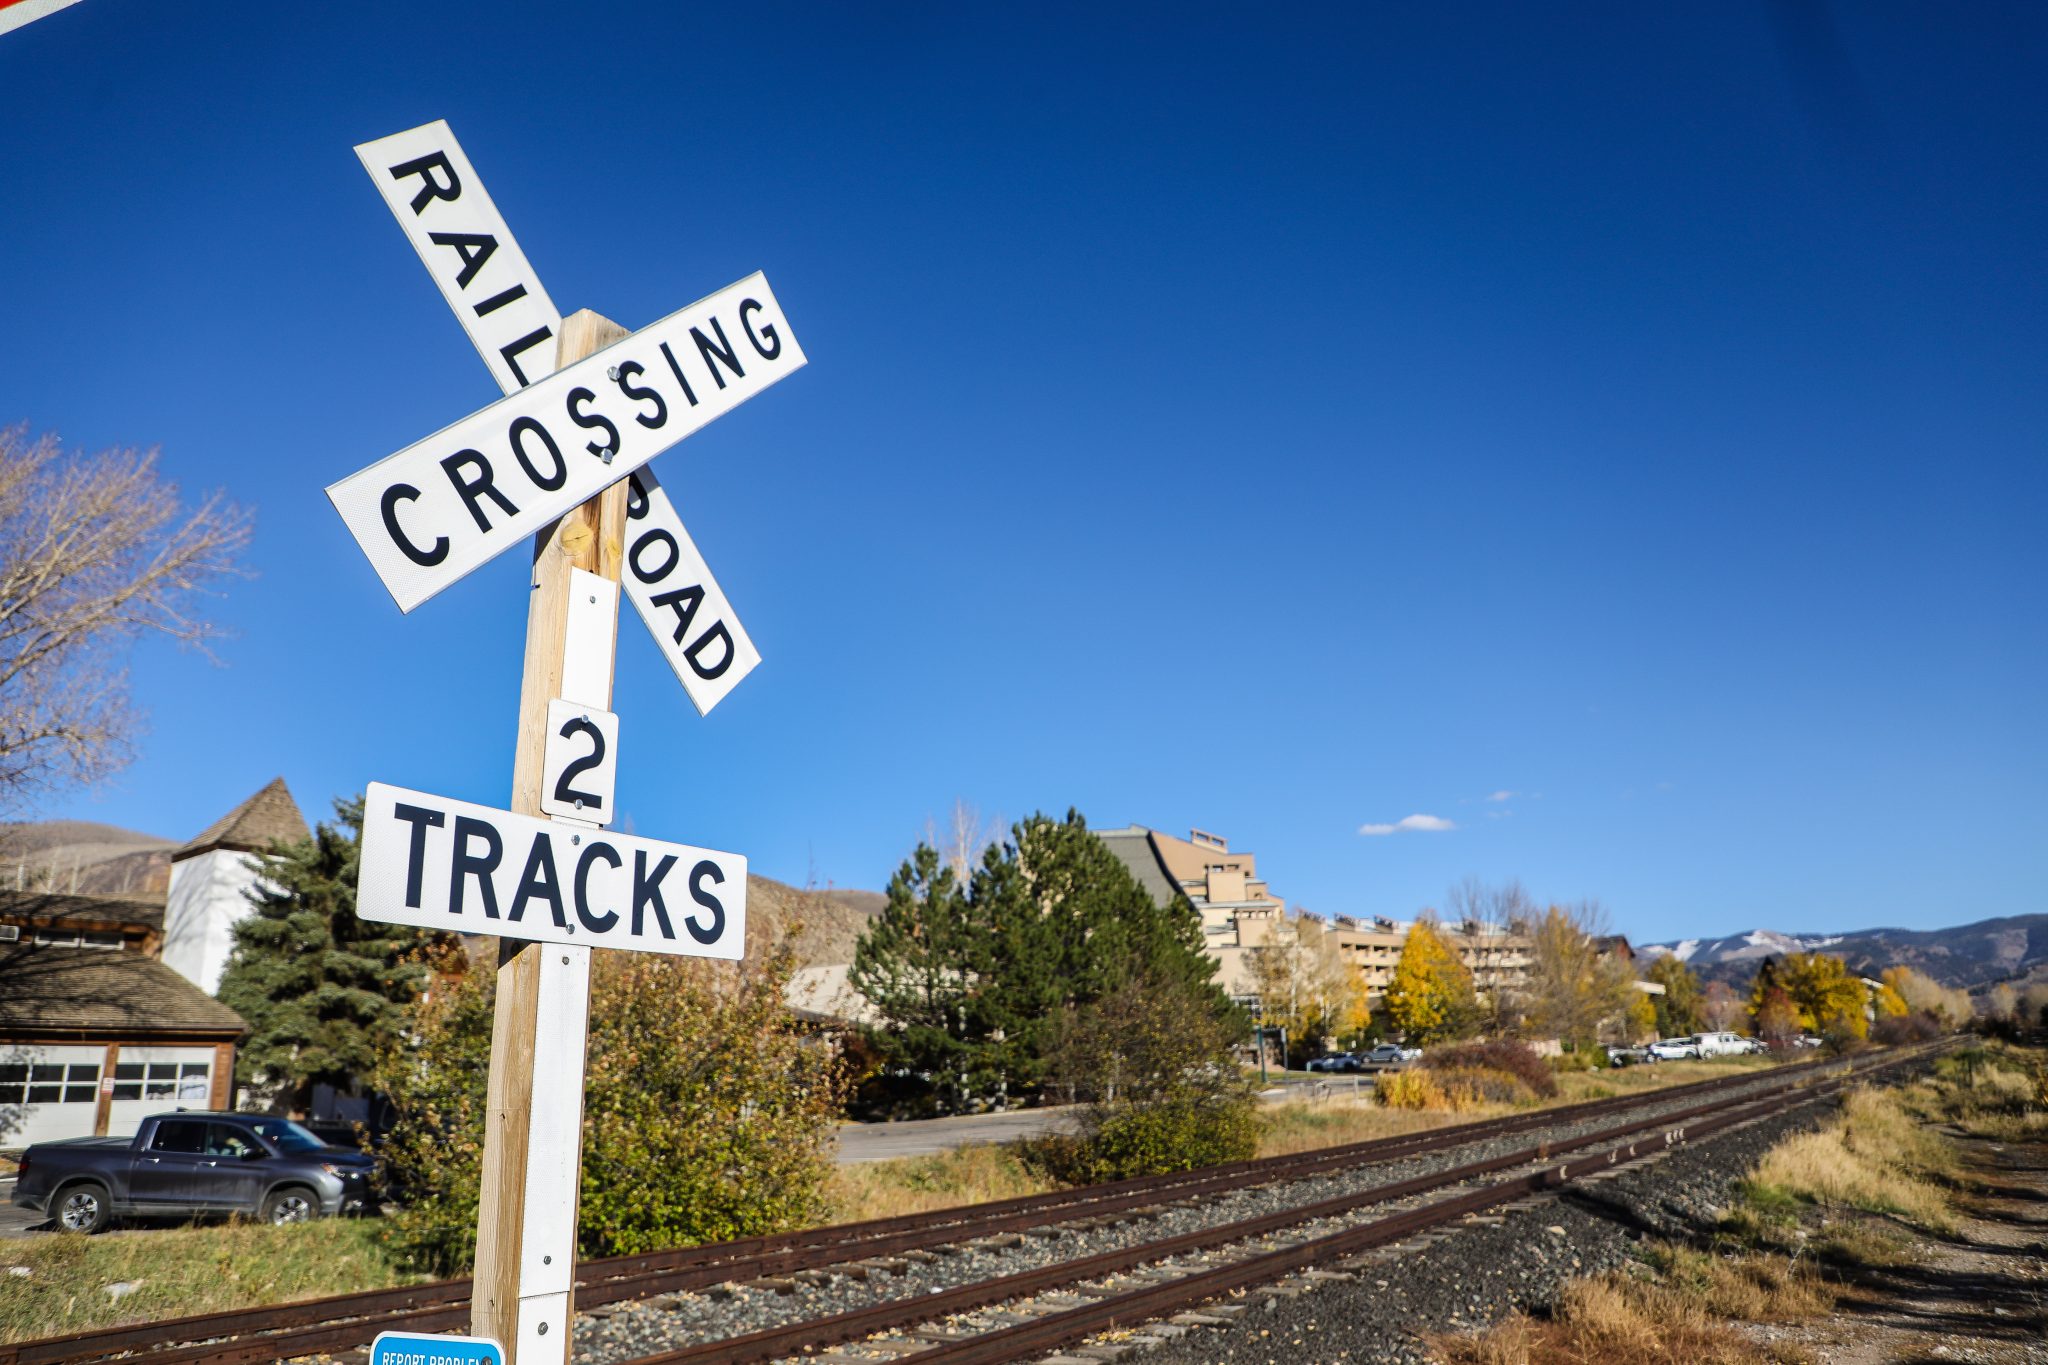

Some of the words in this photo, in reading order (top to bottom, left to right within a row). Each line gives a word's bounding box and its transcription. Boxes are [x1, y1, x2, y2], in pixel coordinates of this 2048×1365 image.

[389, 150, 553, 389] RAIL
[380, 297, 782, 567] CROSSING
[554, 716, 606, 809] 2
[394, 802, 726, 945] TRACKS
[383, 1352, 426, 1365] REPORT
[429, 1356, 479, 1365] PROB
